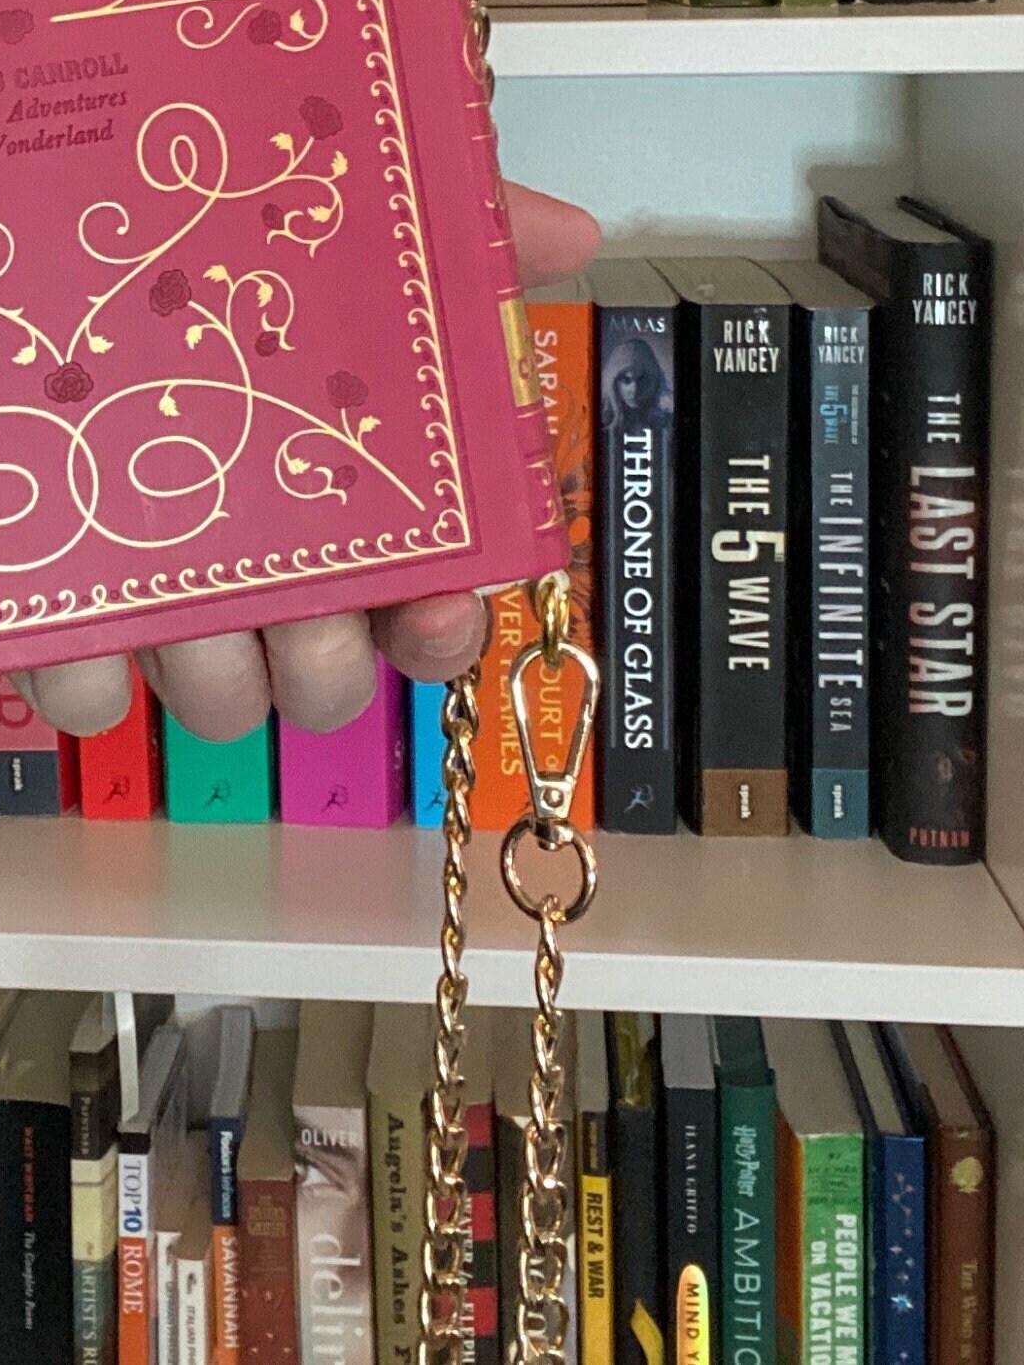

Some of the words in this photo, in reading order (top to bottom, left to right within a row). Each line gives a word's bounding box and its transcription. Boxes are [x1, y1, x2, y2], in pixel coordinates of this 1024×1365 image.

[13, 53, 129, 94] CARROLL
[7, 87, 128, 123] Adventures
[923, 273, 969, 297] RICK
[609, 315, 666, 333] MAAS
[723, 320, 769, 344] RICK
[912, 300, 977, 326] YANCEY
[818, 345, 865, 363] YANCEY
[824, 326, 858, 343] RICK
[713, 346, 780, 373] YANCEY
[927, 392, 961, 444] THE
[623, 428, 654, 579] THRONE
[728, 455, 770, 515] THE
[830, 472, 853, 506] THE
[908, 465, 976, 581] LAST
[623, 588, 653, 635] OF
[728, 576, 770, 671] WAVE
[818, 517, 864, 690] INFINITE
[908, 602, 974, 718] STAR
[624, 642, 653, 750] GLASS
[830, 696, 852, 733] SEA
[12, 756, 22, 791] speak
[739, 784, 752, 819] speak
[833, 784, 844, 819] speak
[909, 827, 970, 847] PUTNAM
[301, 1129, 360, 1147] OLIVER
[684, 1125, 698, 1170] ILANA
[123, 1159, 142, 1203] TOP
[380, 1113, 406, 1233] Angela's
[123, 1204, 142, 1234] 10
[585, 1192, 604, 1236] REST
[685, 1177, 698, 1234] GRIFFO
[24, 1232, 36, 1250] The
[587, 1240, 603, 1256] &
[810, 1240, 827, 1265] ON
[834, 1213, 858, 1297] PEOPLE
[22, 1253, 36, 1297] Complete
[123, 1245, 143, 1315] ROME
[222, 1236, 241, 1349] SAVANNAH
[390, 1245, 407, 1326] Ashes
[587, 1261, 604, 1300] WAR
[82, 1264, 97, 1341] ARTIST'S
[685, 1283, 700, 1340] MIND
[835, 1304, 858, 1339] WE
